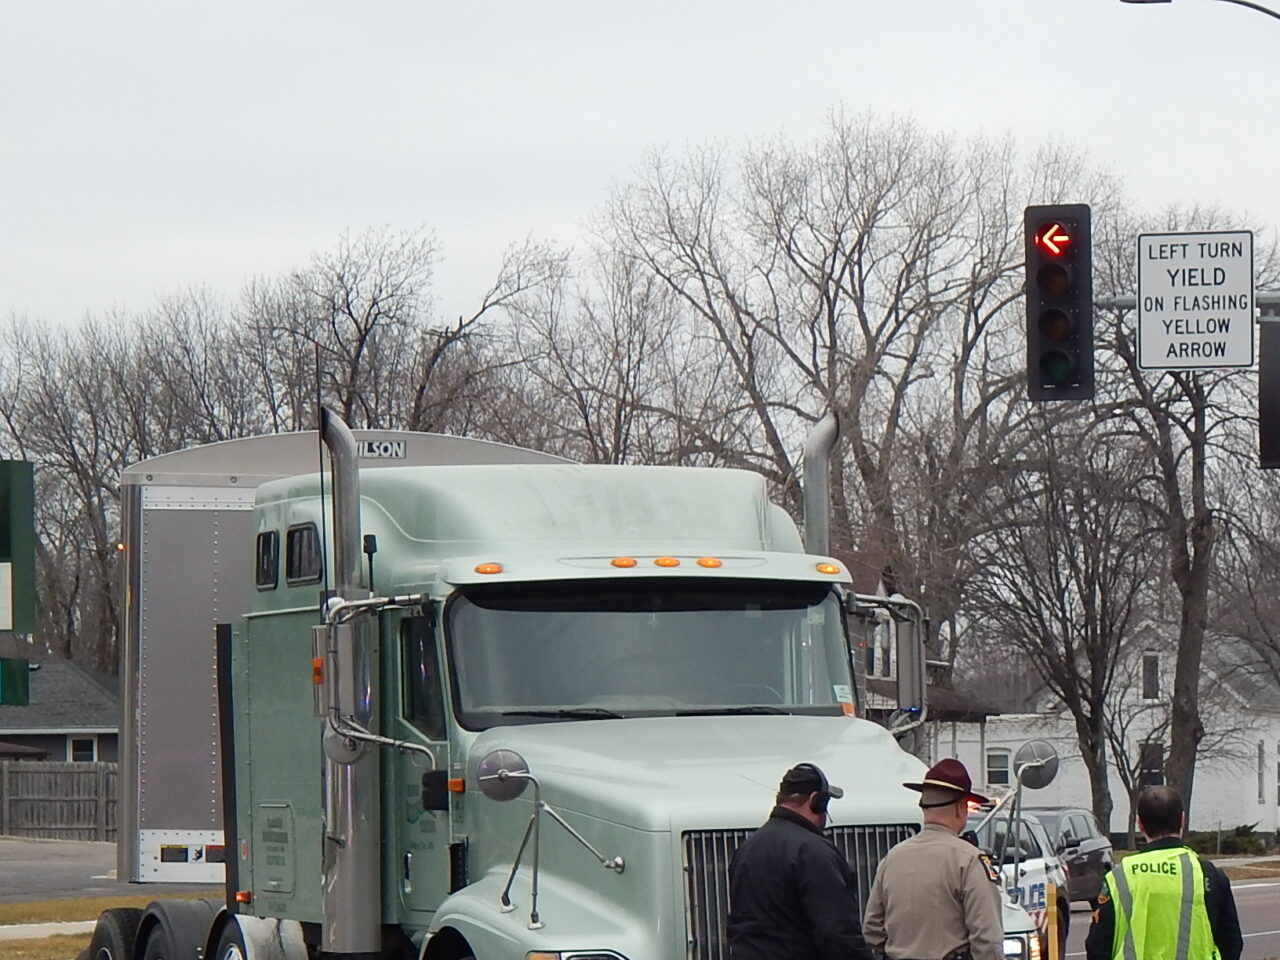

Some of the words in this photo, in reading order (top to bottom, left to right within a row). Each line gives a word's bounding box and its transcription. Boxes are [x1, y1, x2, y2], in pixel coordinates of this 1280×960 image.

[1149, 243, 1189, 260] LEFT
[1198, 242, 1243, 259] TURN
[1166, 267, 1226, 287] YIELD
[1144, 297, 1164, 312] ON
[1174, 294, 1248, 311] FLASHING
[1163, 318, 1230, 335] YELLOW
[1166, 342, 1226, 358] ARROW
[355, 441, 406, 457] ILSON
[1131, 861, 1177, 875] POLICE
